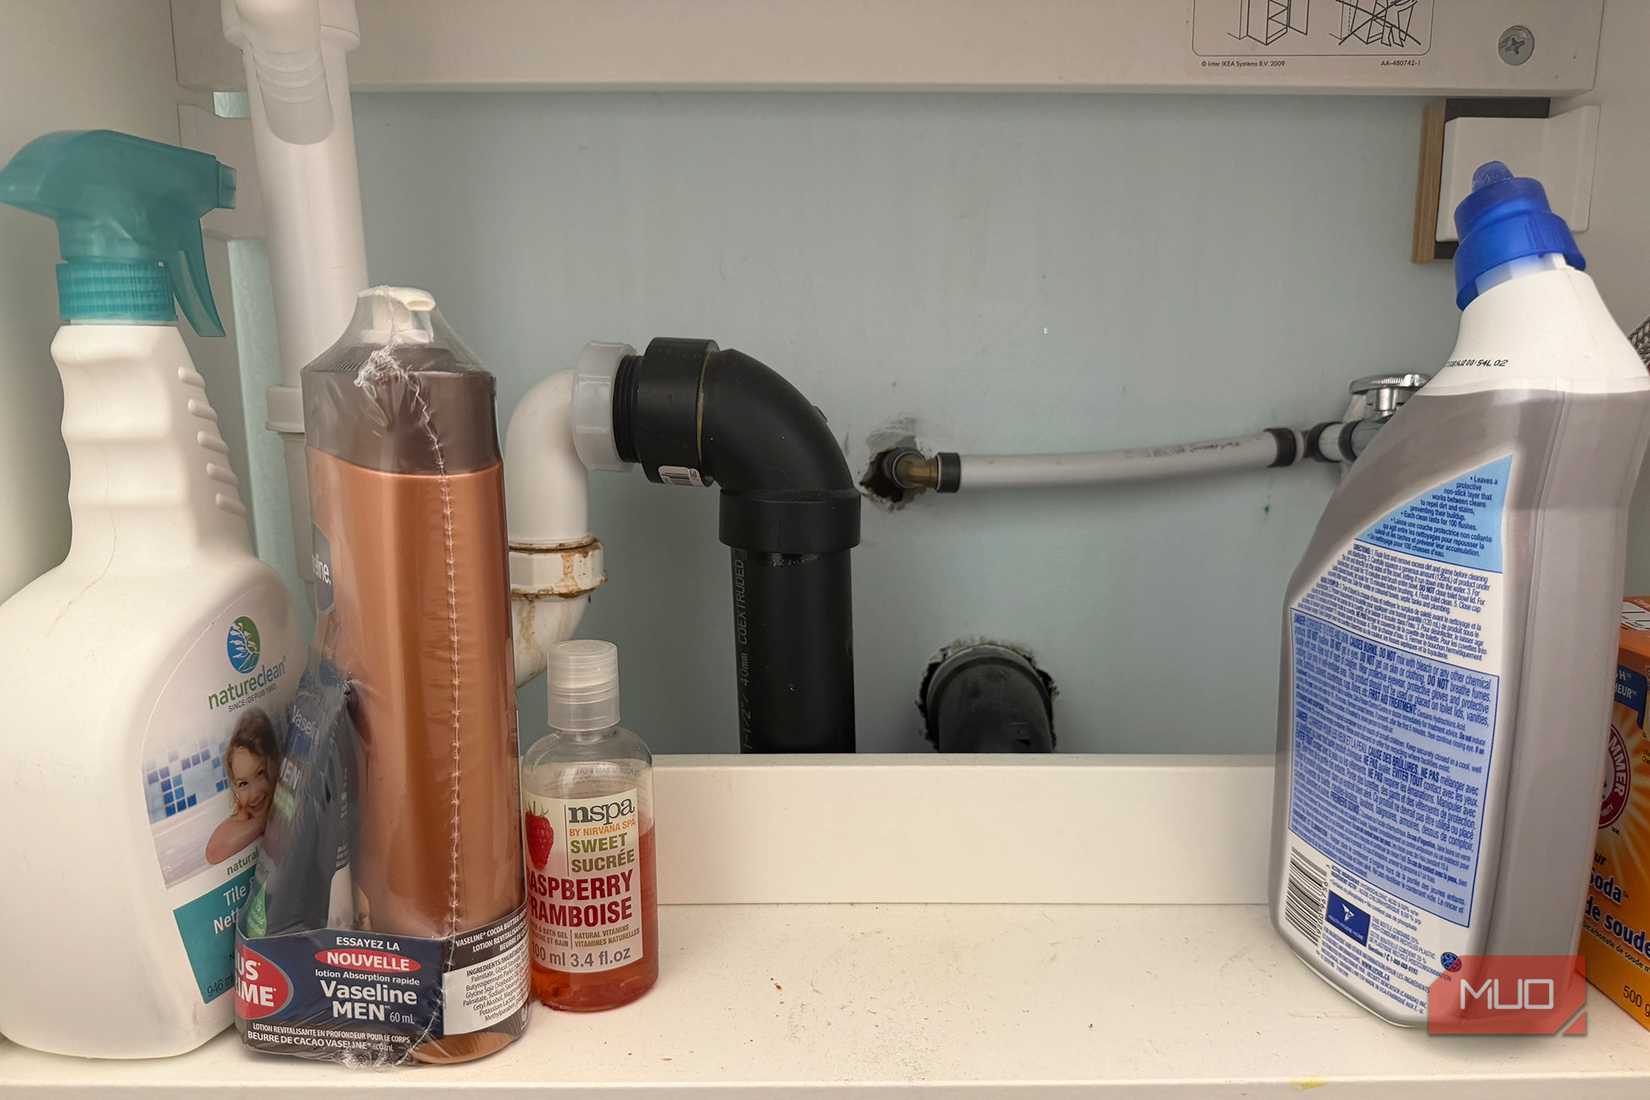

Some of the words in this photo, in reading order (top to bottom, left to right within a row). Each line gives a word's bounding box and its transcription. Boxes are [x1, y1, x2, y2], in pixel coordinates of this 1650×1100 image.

[734, 560, 748, 645] COEXTRUDED
[208, 660, 286, 710] natureclean
[1437, 676, 1448, 690] NOT
[1428, 769, 1439, 783] PAS
[568, 798, 636, 824] nspa
[569, 827, 580, 837] BY
[583, 823, 620, 836] NIRVANA
[570, 832, 628, 854] SWEET
[572, 848, 636, 873] SUCRÉE
[224, 884, 247, 906] Tile
[530, 896, 632, 928] RAMBOISE
[486, 924, 504, 937] COCOA
[574, 932, 600, 940] NATURAL
[336, 936, 384, 949] ESSAYEZ
[386, 941, 400, 950] LA
[472, 940, 494, 952] LOTION
[327, 952, 410, 972] NOUVELLE
[550, 952, 566, 966] ml
[570, 952, 594, 967] 3.4
[598, 948, 631, 966] fl.oz
[315, 969, 340, 978] lotion
[342, 971, 390, 982] Absorption
[392, 977, 420, 986] rapide
[320, 980, 417, 1005] Vaseline
[1623, 985, 1642, 1008] 500
[332, 1000, 385, 1021] MEN
[390, 1012, 400, 1022] 60
[402, 1014, 415, 1024] mL
[248, 1030, 280, 1043] BEURRE
[280, 1036, 293, 1044] DE
[293, 1036, 325, 1047] CACAO
[252, 1022, 272, 1032] LOTION
[273, 1025, 316, 1037] REVITALISANTE
